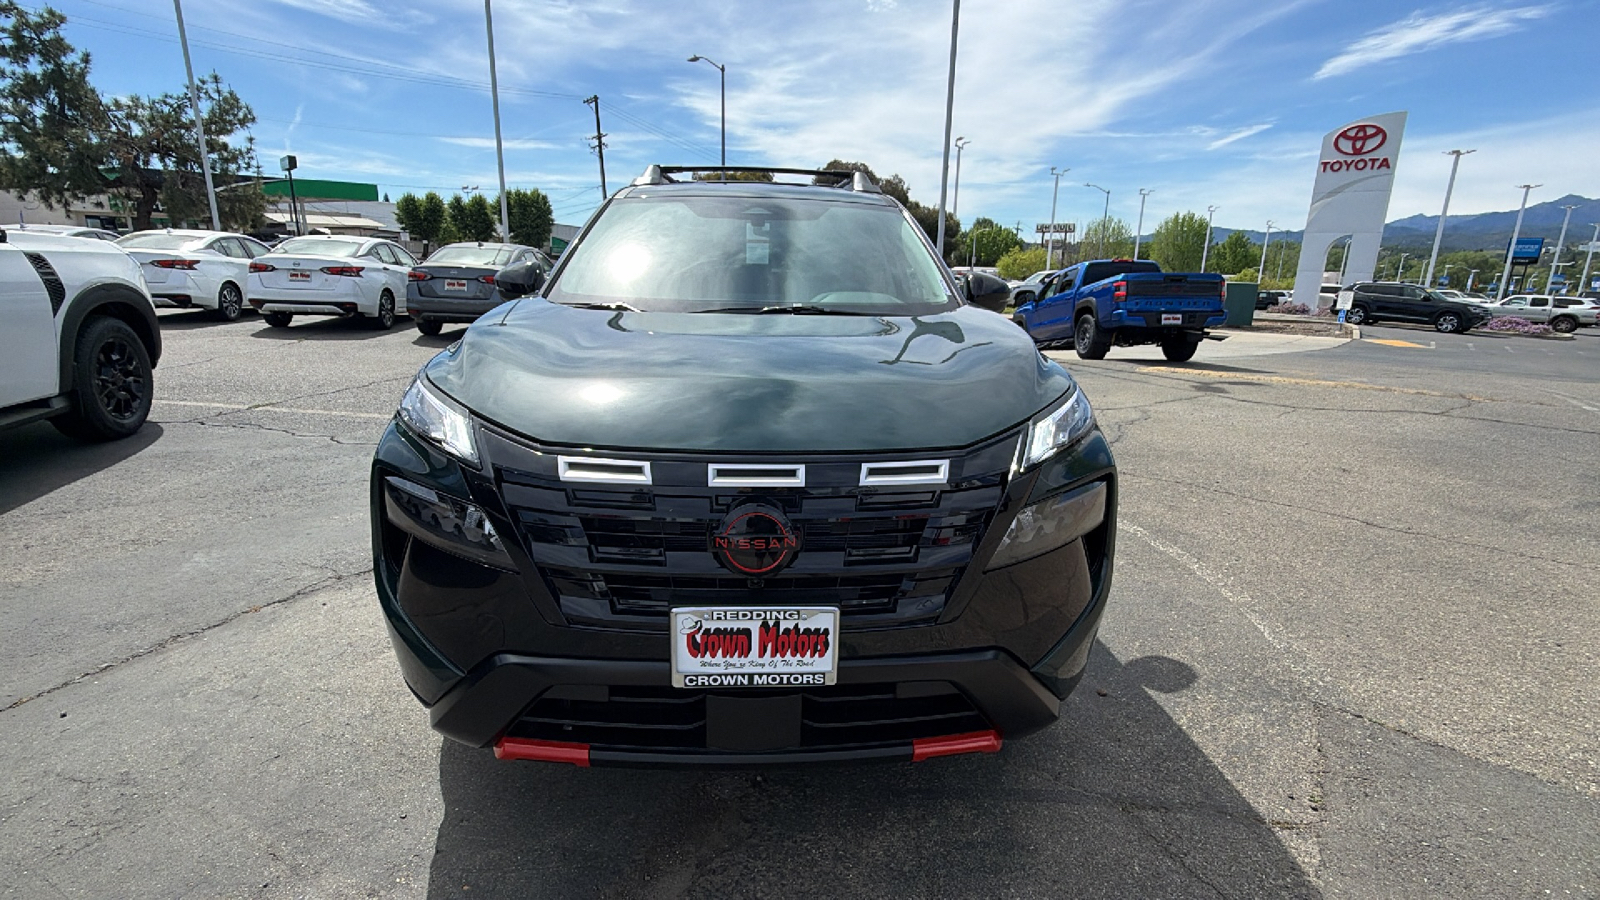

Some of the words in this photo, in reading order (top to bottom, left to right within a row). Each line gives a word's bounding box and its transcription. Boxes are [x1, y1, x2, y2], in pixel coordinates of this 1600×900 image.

[1321, 157, 1391, 173] TOYOTA
[715, 536, 797, 549] NISSAN
[712, 611, 799, 620] REDDING
[686, 622, 752, 659] Crown
[758, 620, 830, 659] Motors
[700, 660, 722, 668] Where
[748, 660, 766, 669] King
[768, 660, 779, 669] Of
[780, 660, 793, 668] The
[795, 660, 816, 668] Road
[685, 675, 749, 686] CROWN
[753, 674, 825, 685] MOTORS
